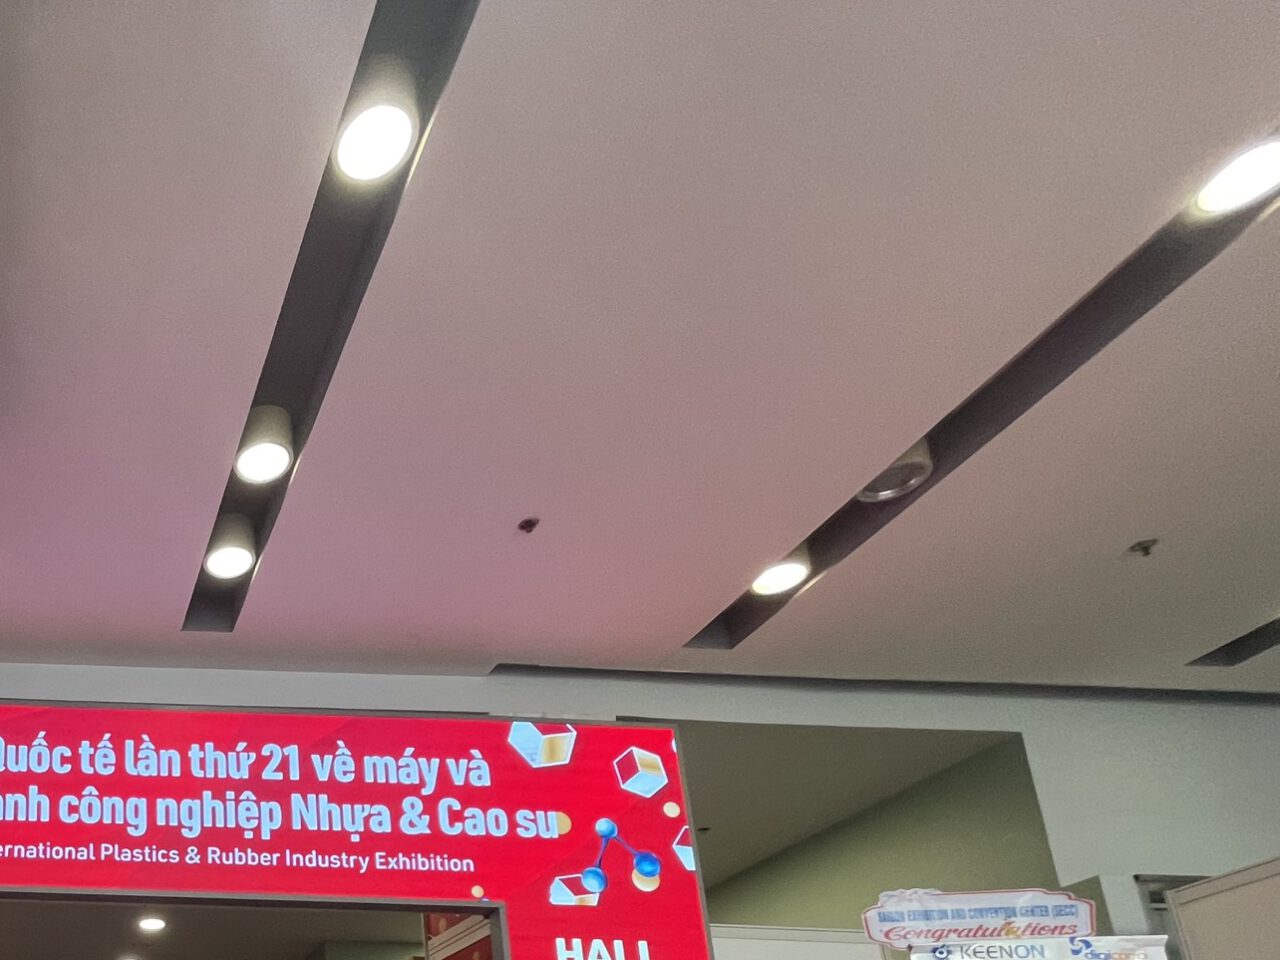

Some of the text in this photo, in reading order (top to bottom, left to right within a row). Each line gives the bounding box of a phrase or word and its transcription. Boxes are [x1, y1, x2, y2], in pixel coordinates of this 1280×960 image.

[79, 732, 116, 775] tế
[125, 734, 180, 778] lần
[190, 741, 256, 780] thứ
[263, 747, 299, 781] 21
[311, 740, 356, 784] về
[364, 746, 439, 795] máy
[446, 749, 490, 787] và
[59, 786, 147, 837] công
[157, 791, 282, 840] nghiệp
[291, 793, 391, 842] Nhựa
[401, 797, 430, 834] &
[438, 797, 508, 837] Cao
[516, 808, 559, 839] su
[101, 844, 179, 864] Plastics
[186, 847, 201, 864] &
[207, 848, 278, 867] Rubber
[285, 849, 369, 872] Industry
[375, 852, 475, 873] Exhibition
[960, 945, 1045, 960] KEENON
